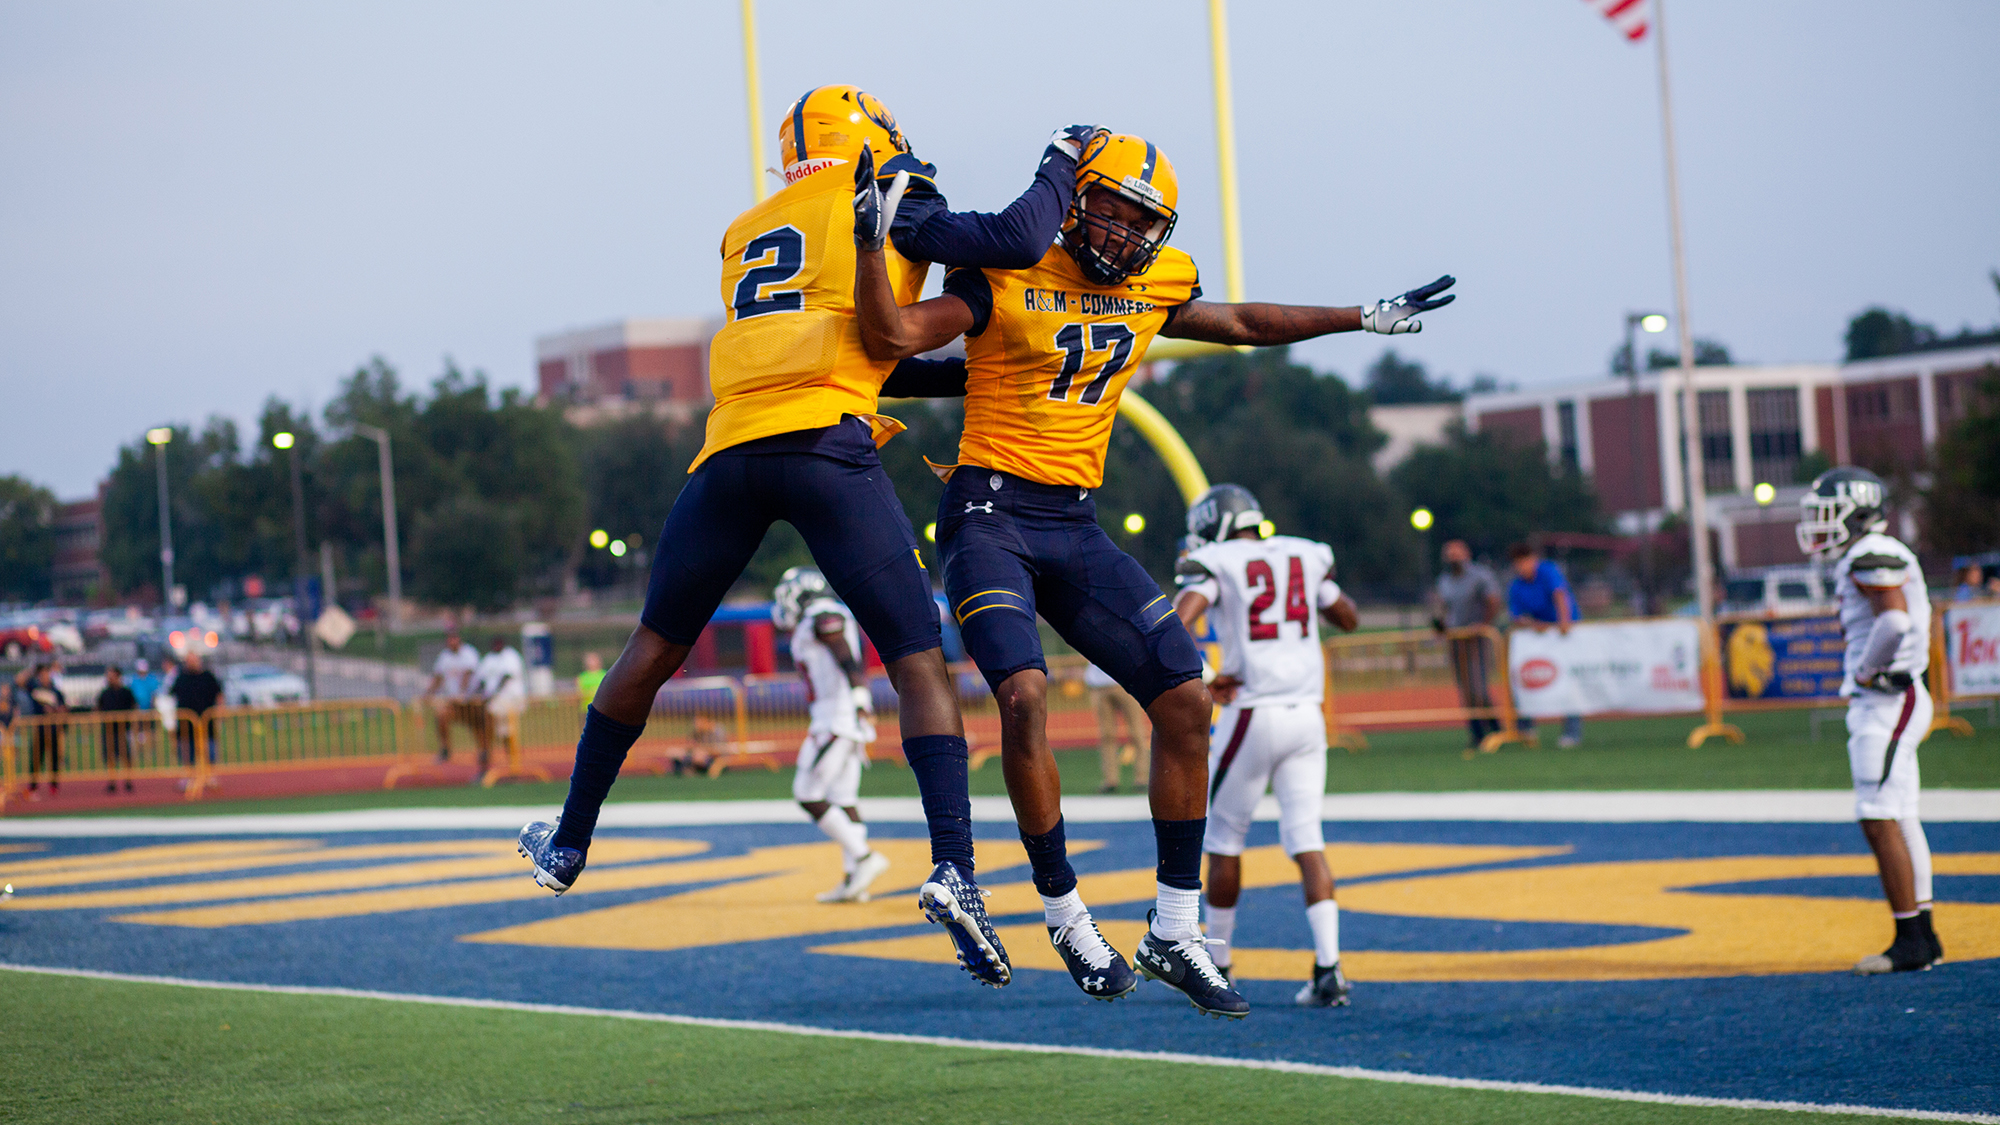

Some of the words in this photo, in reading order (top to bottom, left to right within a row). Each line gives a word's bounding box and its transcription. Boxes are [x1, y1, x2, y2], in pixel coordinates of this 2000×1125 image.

[1133, 179, 1154, 196] LIONS
[731, 223, 806, 323] 2
[1024, 287, 1067, 313] A&M
[1046, 322, 1136, 407] 17
[1245, 556, 1310, 641] 24
